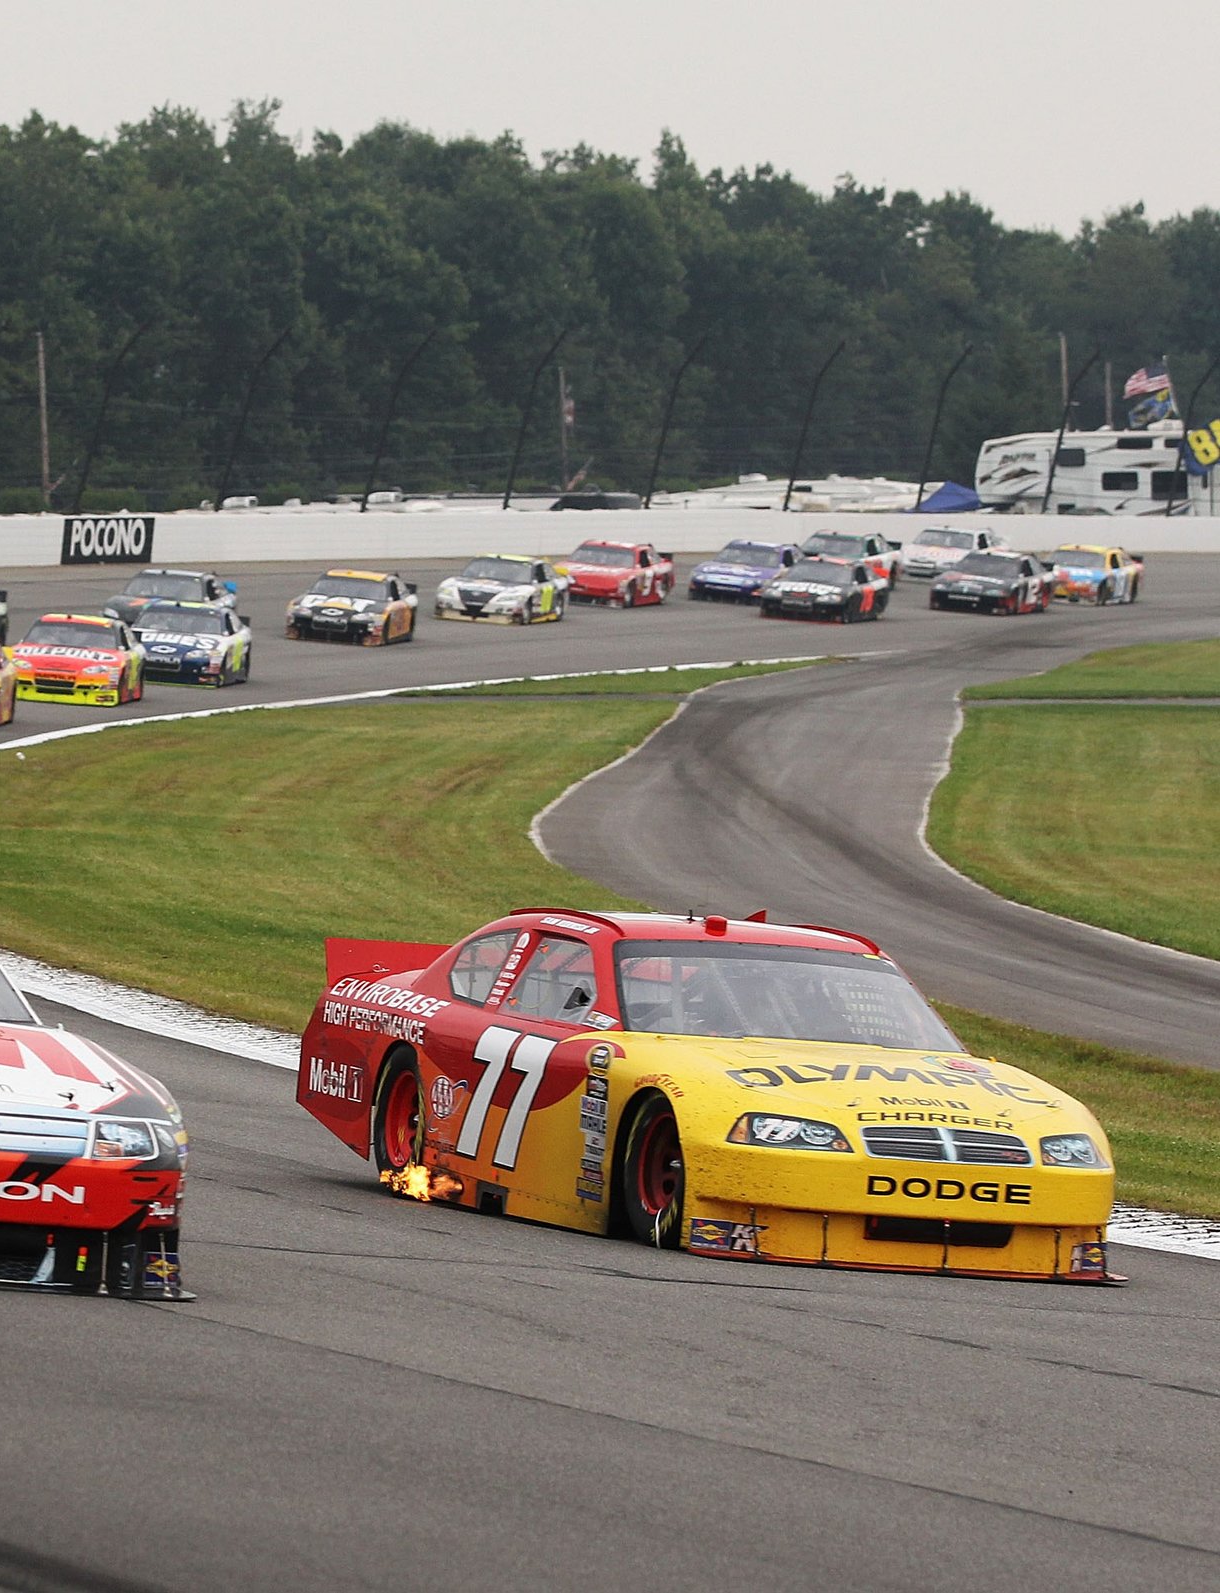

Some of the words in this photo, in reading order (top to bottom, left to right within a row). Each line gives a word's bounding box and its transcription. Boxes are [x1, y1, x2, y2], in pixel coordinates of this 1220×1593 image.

[70, 519, 146, 557] POCONO
[330, 977, 451, 1018] ENVIROBASE
[323, 1000, 349, 1027] HIGH
[349, 1006, 426, 1045] PERFORMANCE
[309, 1056, 347, 1099] Mobil
[455, 1024, 559, 1170] 77
[726, 1063, 1049, 1106] OLYMPIC
[857, 1111, 1014, 1131] CHARGER
[878, 1096, 945, 1107] Mobil
[755, 1117, 802, 1142] 77
[867, 1175, 1033, 1205] DODGE
